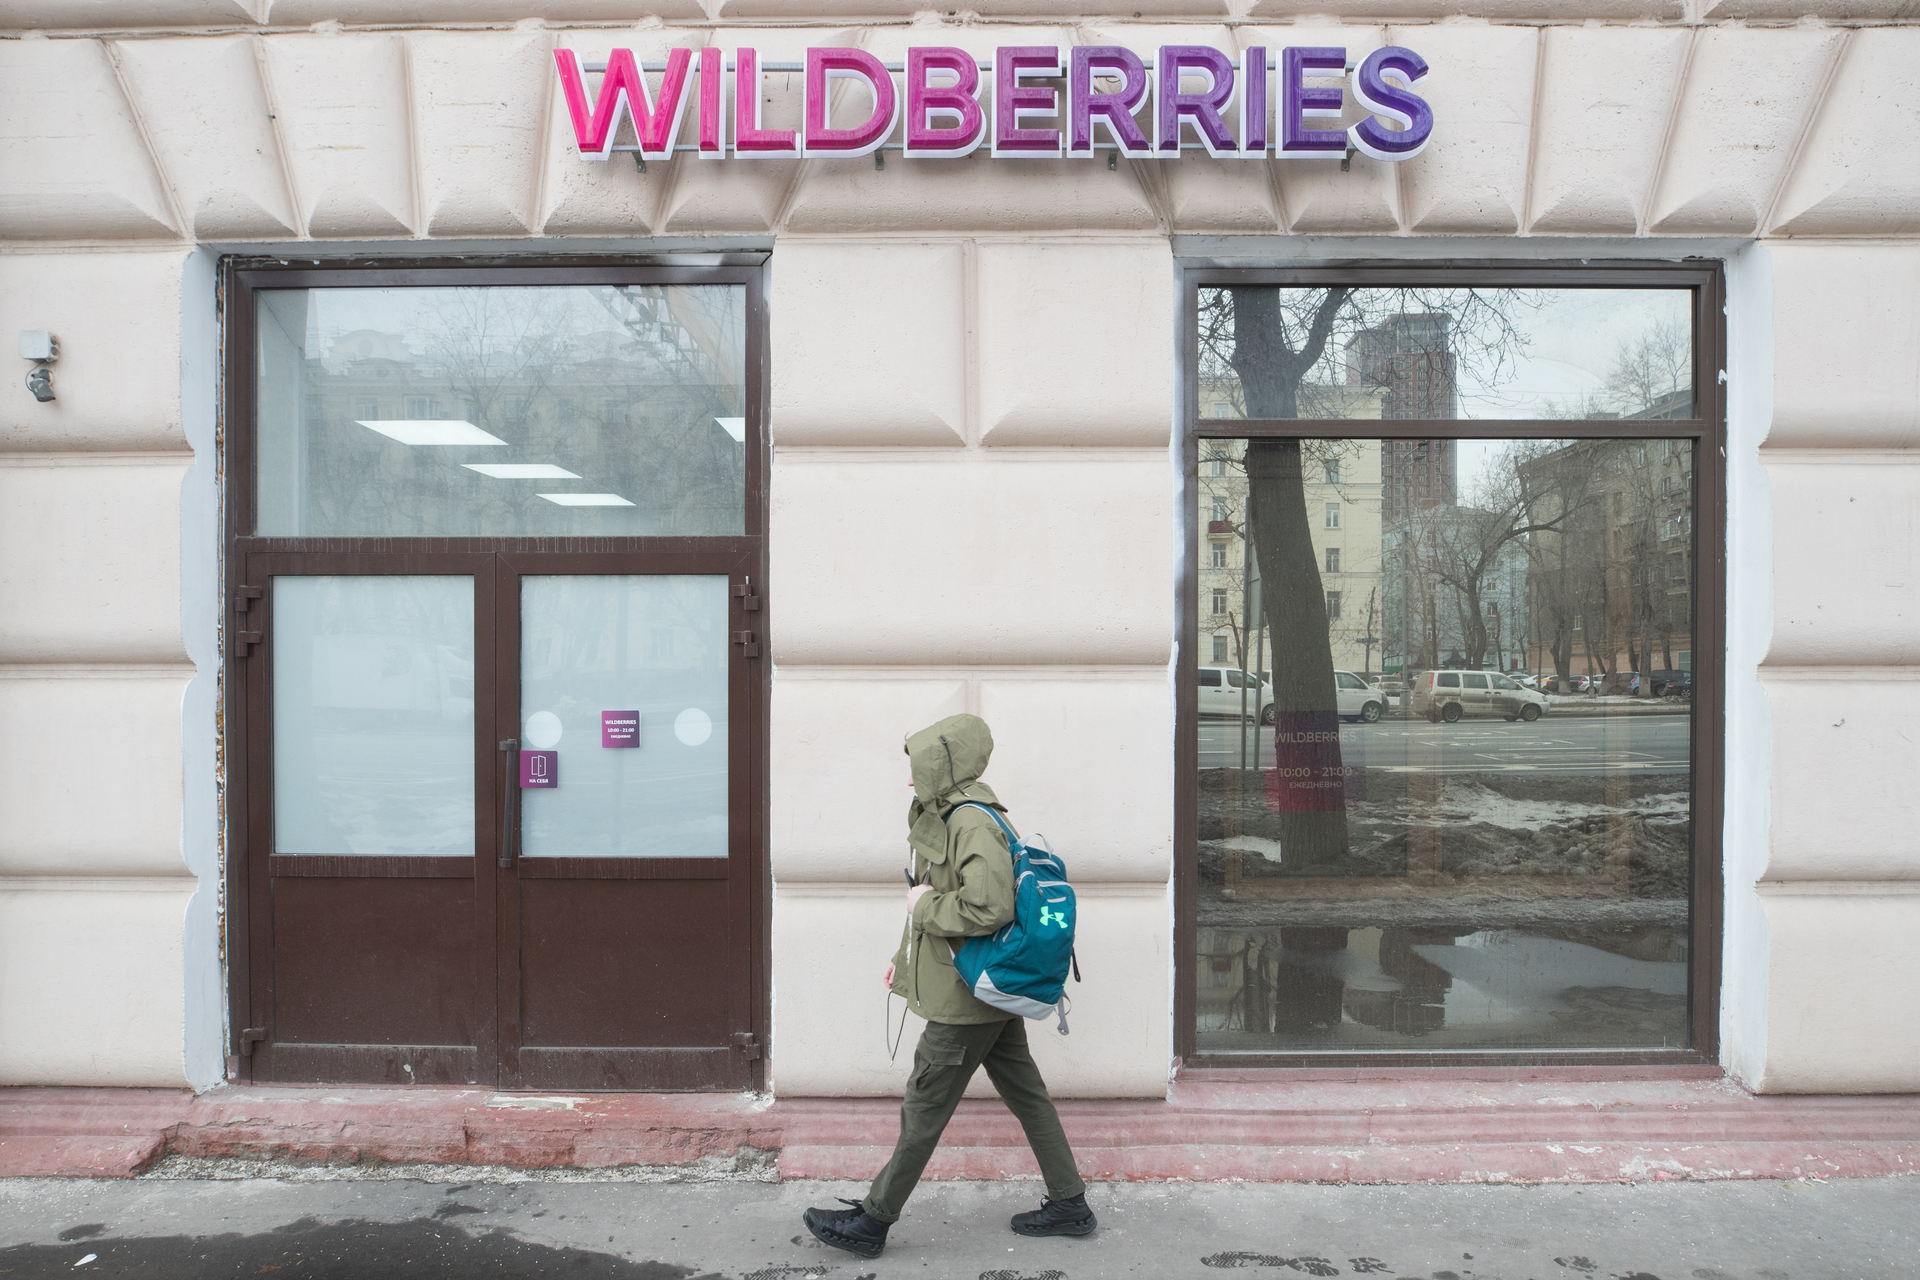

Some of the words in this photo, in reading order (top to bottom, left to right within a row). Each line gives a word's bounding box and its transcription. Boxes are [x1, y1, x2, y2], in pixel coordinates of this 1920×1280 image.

[552, 46, 1434, 162] WILDBERRIES
[1275, 732, 1357, 743] WILDBERRIES
[1279, 768, 1311, 778] 10:00
[1322, 767, 1353, 777] 21:00
[1289, 781, 1343, 789] ЕЖЕДНЕВНО
